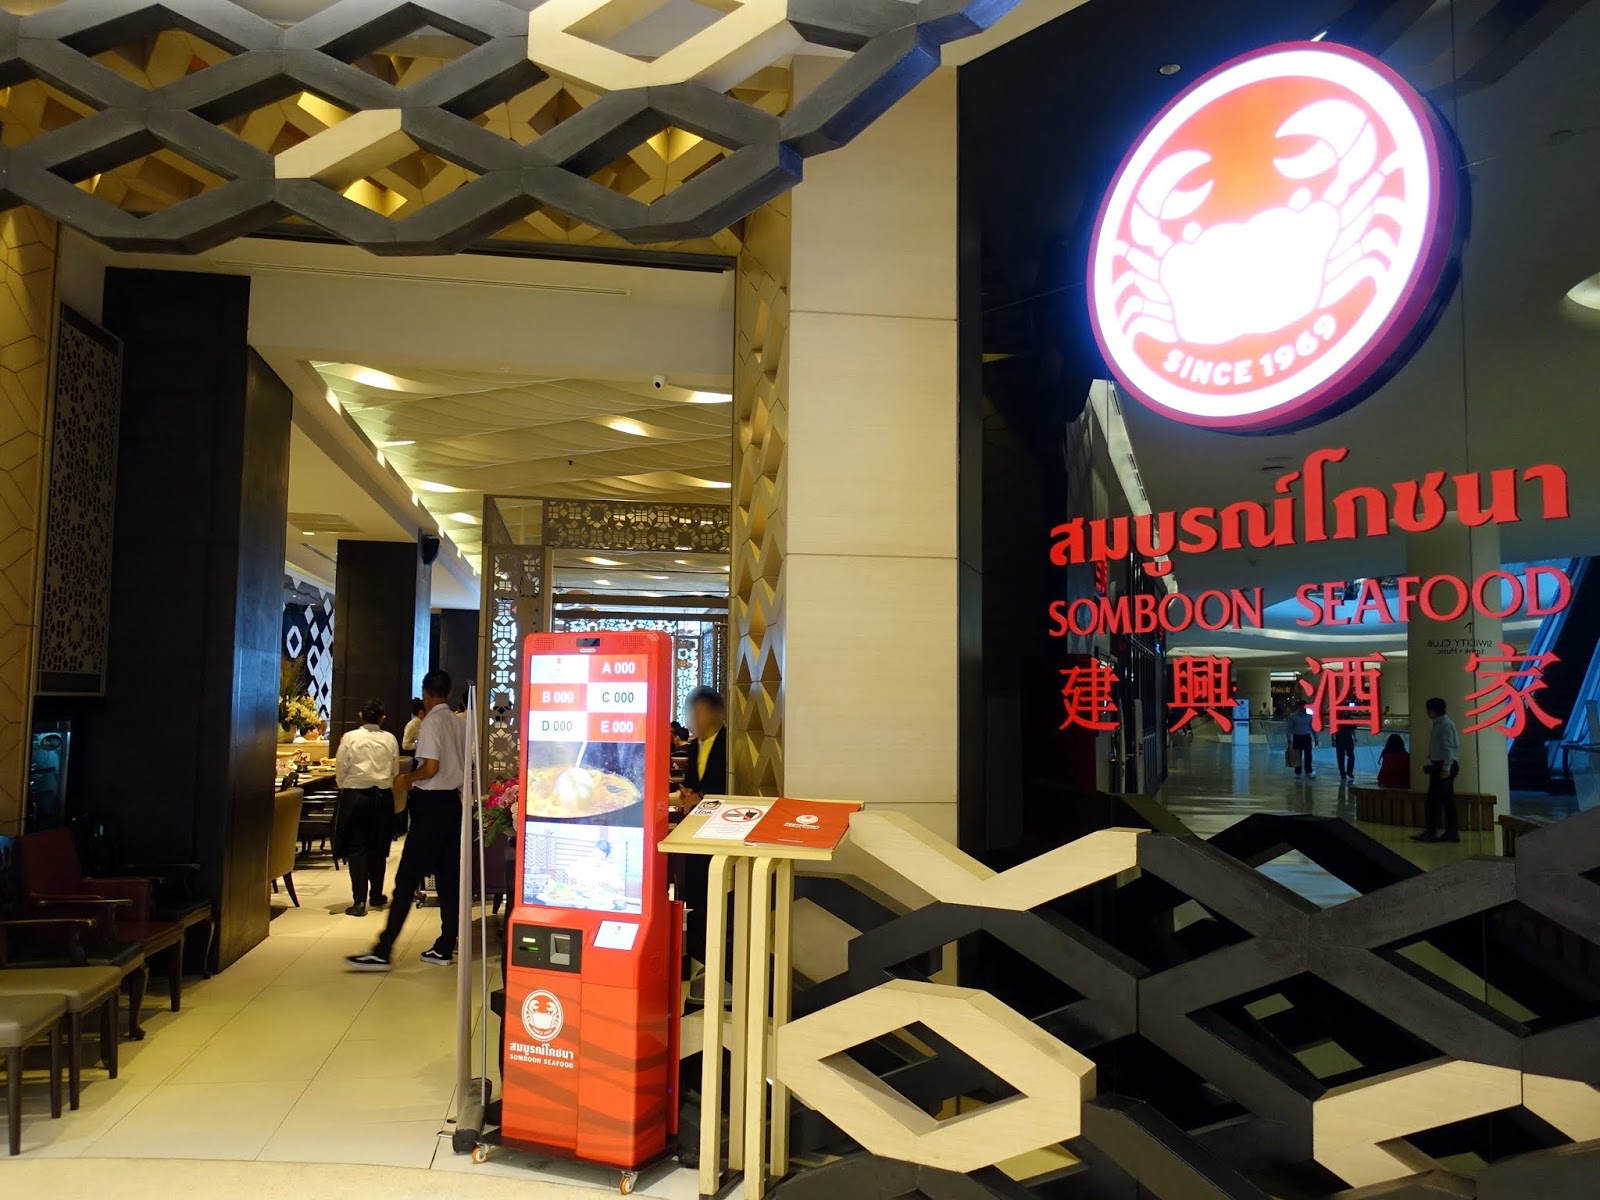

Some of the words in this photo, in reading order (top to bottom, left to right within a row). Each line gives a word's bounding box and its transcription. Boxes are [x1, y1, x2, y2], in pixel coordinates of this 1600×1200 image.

[1163, 349, 1253, 385] SINCE
[1259, 313, 1337, 377] 1969
[1048, 586, 1264, 638] SOMBOON
[1295, 565, 1573, 627] SEAFOOD
[602, 662, 612, 674] A
[614, 661, 636, 674] 000
[1058, 642, 1563, 738] 建興酒家
[542, 691, 551, 703] B
[553, 691, 574, 704] 000
[602, 692, 610, 703] C
[614, 692, 635, 703] 000
[542, 720, 550, 732] D
[553, 720, 573, 732] 000
[601, 720, 610, 733] E
[612, 720, 634, 733] 000
[510, 1054, 541, 1063] SOMBOON
[544, 1059, 573, 1068] SEAFOOD
